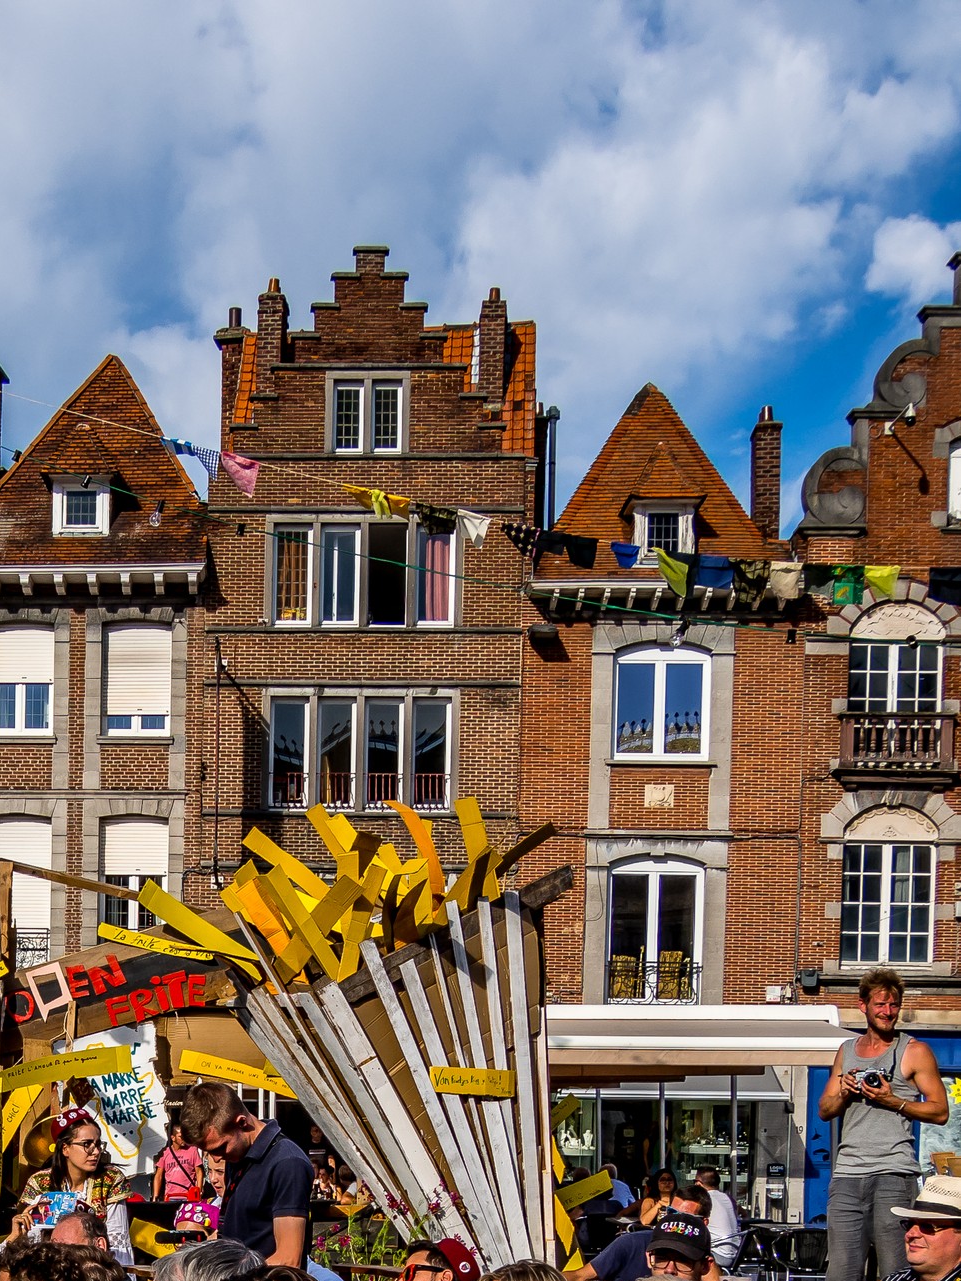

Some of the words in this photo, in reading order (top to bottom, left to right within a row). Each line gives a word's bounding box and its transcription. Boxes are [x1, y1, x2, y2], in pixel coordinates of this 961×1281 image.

[100, 1086, 151, 1112] MARRE
[104, 1102, 157, 1126] MARRE
[660, 1221, 700, 1236] GUESS
